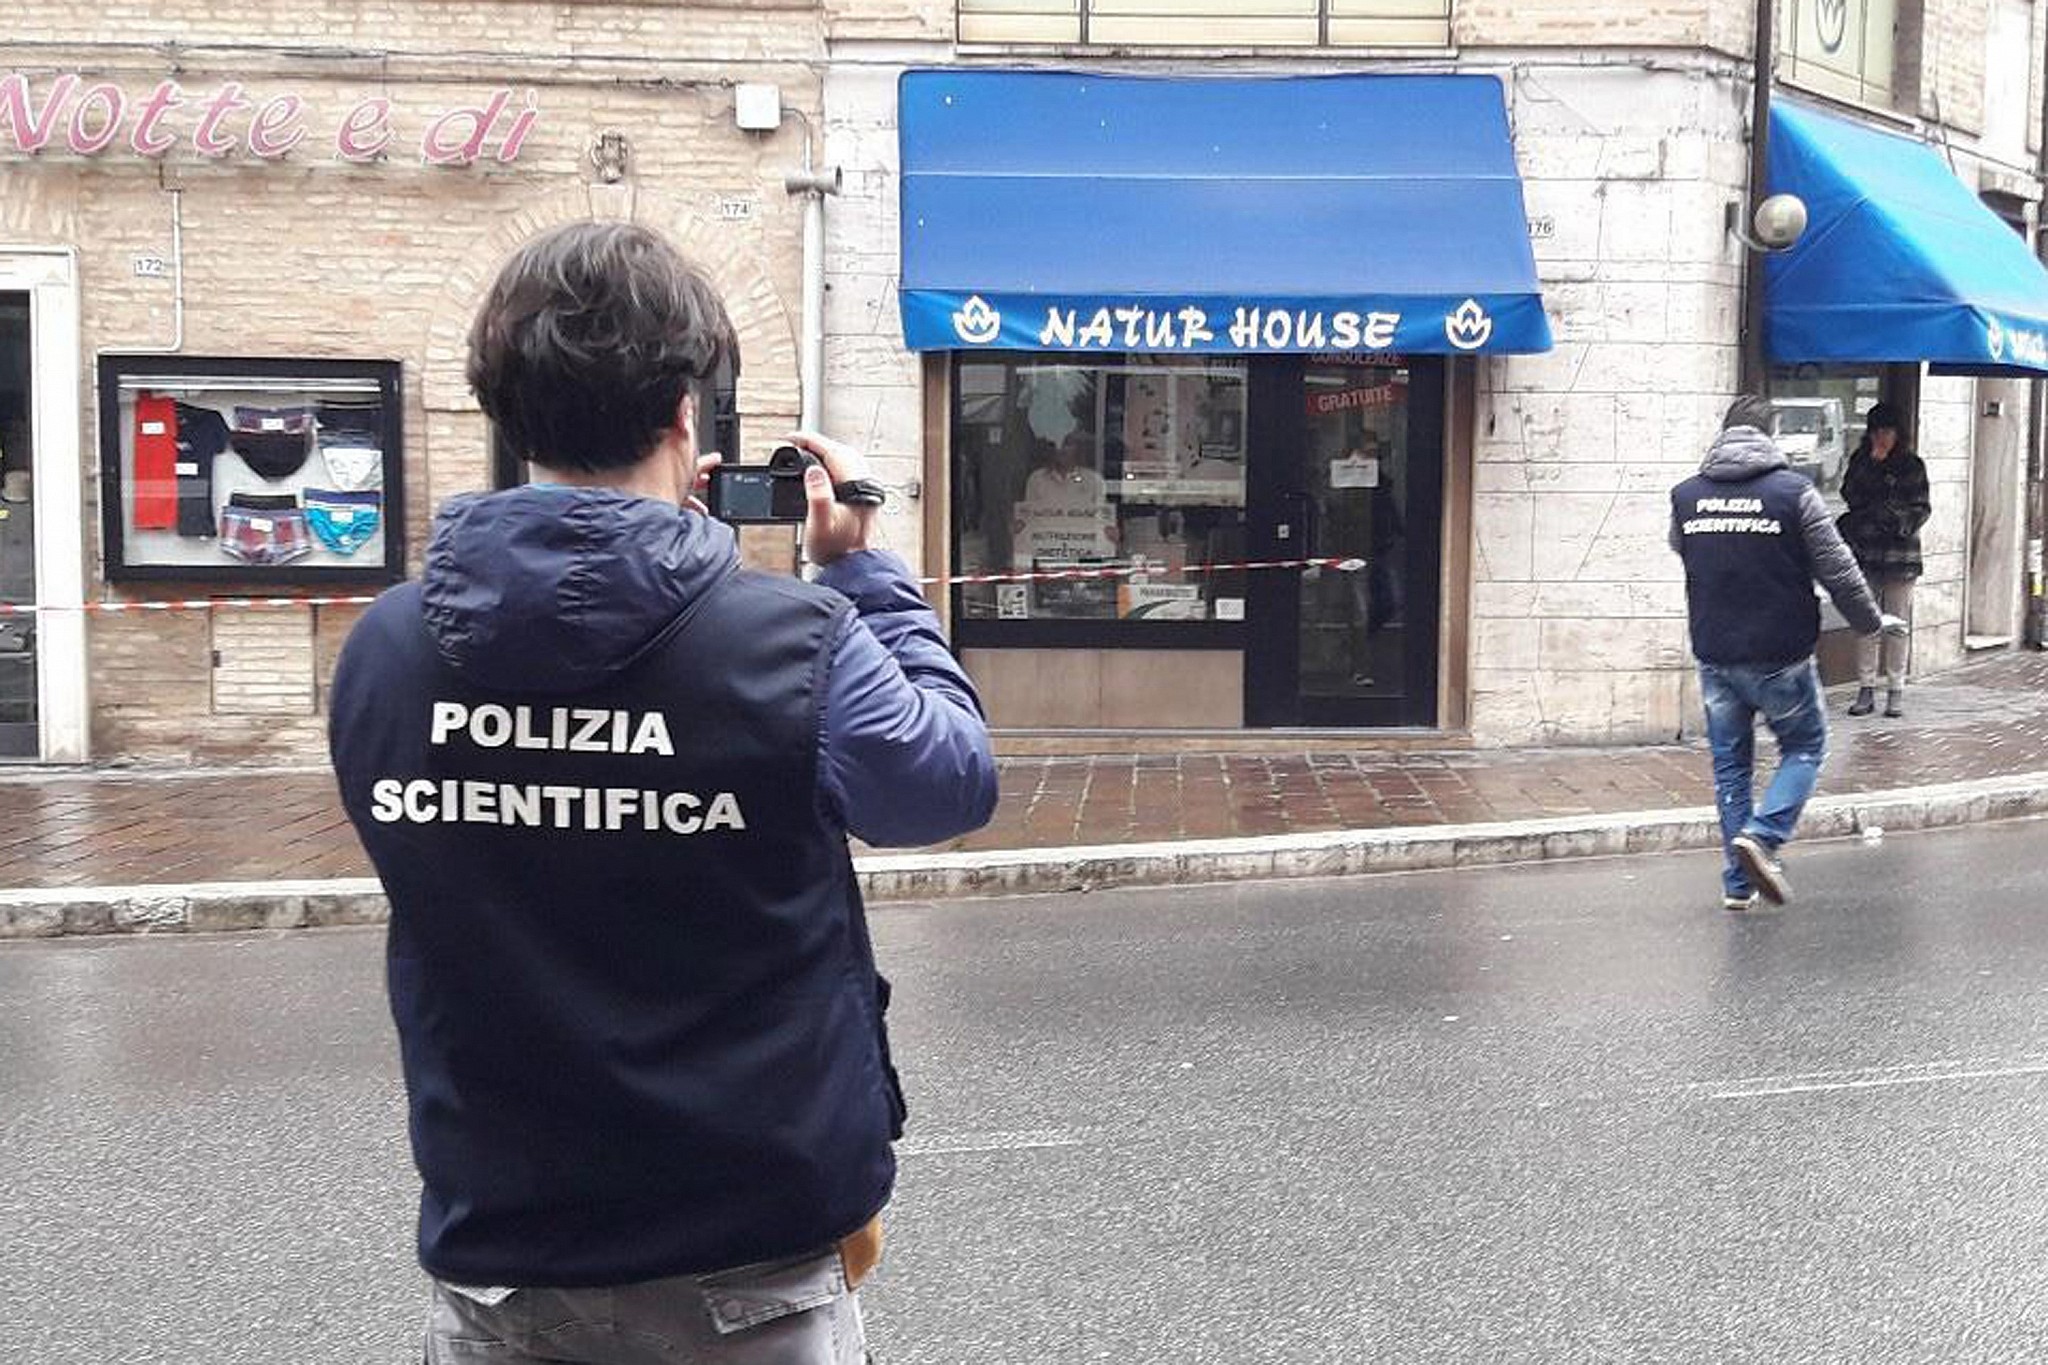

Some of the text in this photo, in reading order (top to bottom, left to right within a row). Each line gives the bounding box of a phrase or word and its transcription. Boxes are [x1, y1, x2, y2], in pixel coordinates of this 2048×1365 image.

[0, 73, 302, 157] Notte
[336, 97, 394, 160] e
[724, 203, 749, 215] 174
[1528, 221, 1551, 234] 176
[137, 258, 163, 271] 172
[1040, 304, 1400, 350] NATUR HOUSE
[1318, 384, 1393, 412] GRATUITE
[1696, 498, 1763, 513] POLIZIA
[1682, 518, 1782, 535] SCIENTIFICA
[430, 702, 675, 756] POLIZIA
[370, 778, 747, 834] SCIENTIFICA
